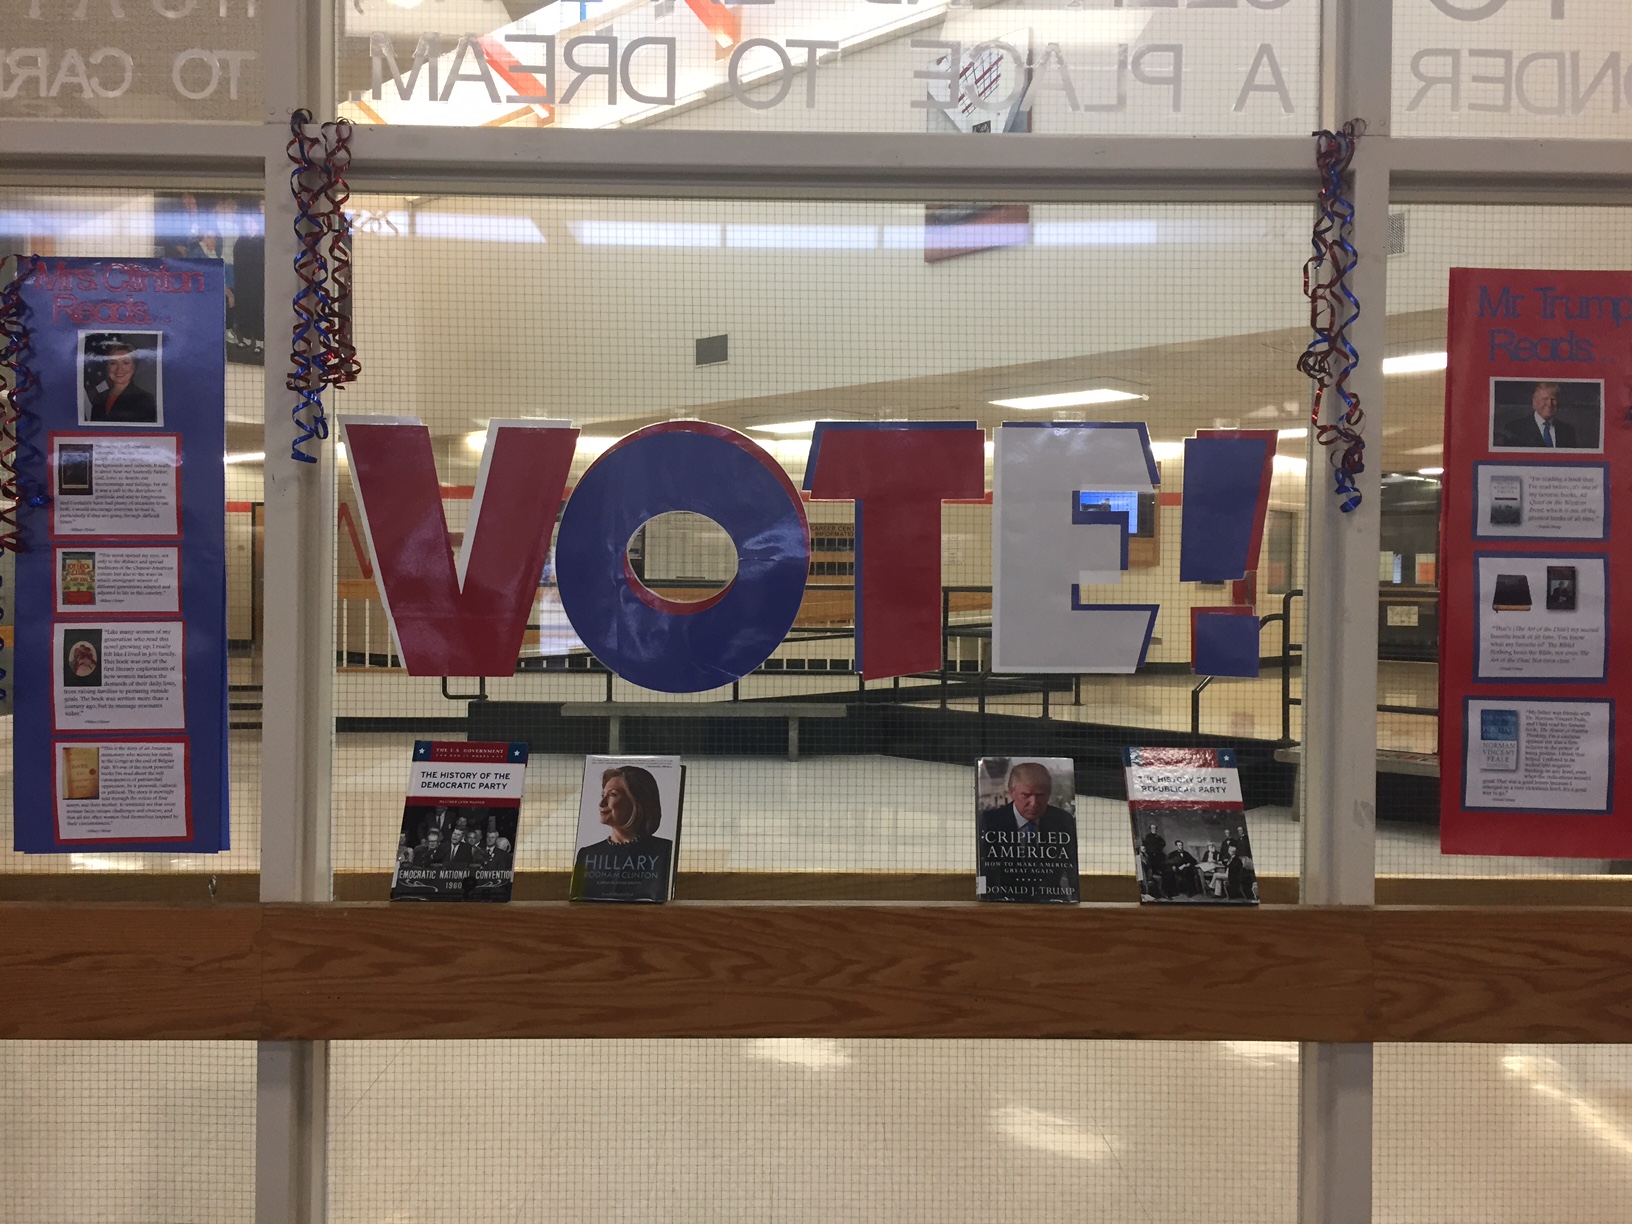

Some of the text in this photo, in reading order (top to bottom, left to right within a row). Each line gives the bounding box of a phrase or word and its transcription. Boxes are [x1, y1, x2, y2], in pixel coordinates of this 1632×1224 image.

[103, 263, 205, 293] Clinton
[1533, 287, 1632, 328] Trump
[478, 782, 507, 790] PARTY
[985, 831, 1071, 844] CRIPPLED
[987, 845, 1069, 859] AMERICA
[585, 854, 659, 870] HILLARY
[399, 870, 437, 879] EMOCRATIC
[1039, 887, 1075, 895] TRUMP
